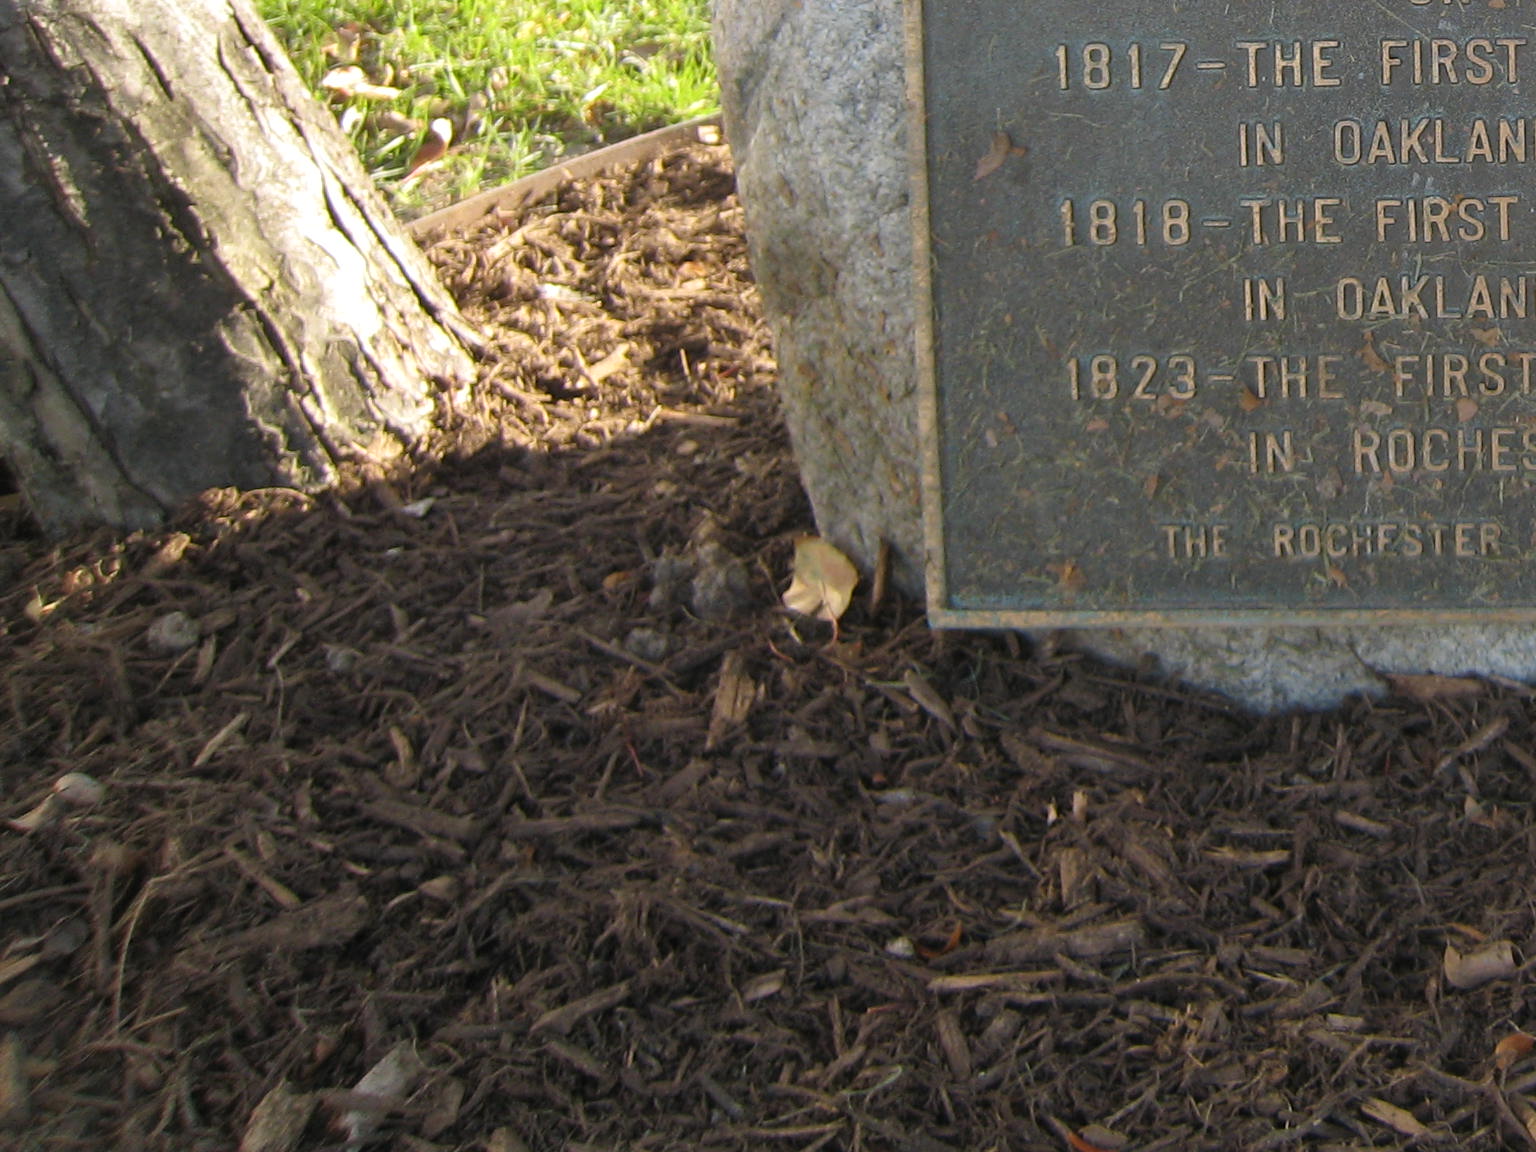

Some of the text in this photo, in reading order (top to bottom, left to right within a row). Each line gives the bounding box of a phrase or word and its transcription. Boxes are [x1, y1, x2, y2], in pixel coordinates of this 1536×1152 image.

[1381, 37, 1527, 86] FIRST
[1239, 121, 1285, 167] IN
[1376, 194, 1519, 243] FIRST
[1243, 276, 1286, 322] IN
[1250, 431, 1295, 474] IN
[1162, 523, 1230, 559] THE
[1274, 521, 1502, 557] ROCHESTER
